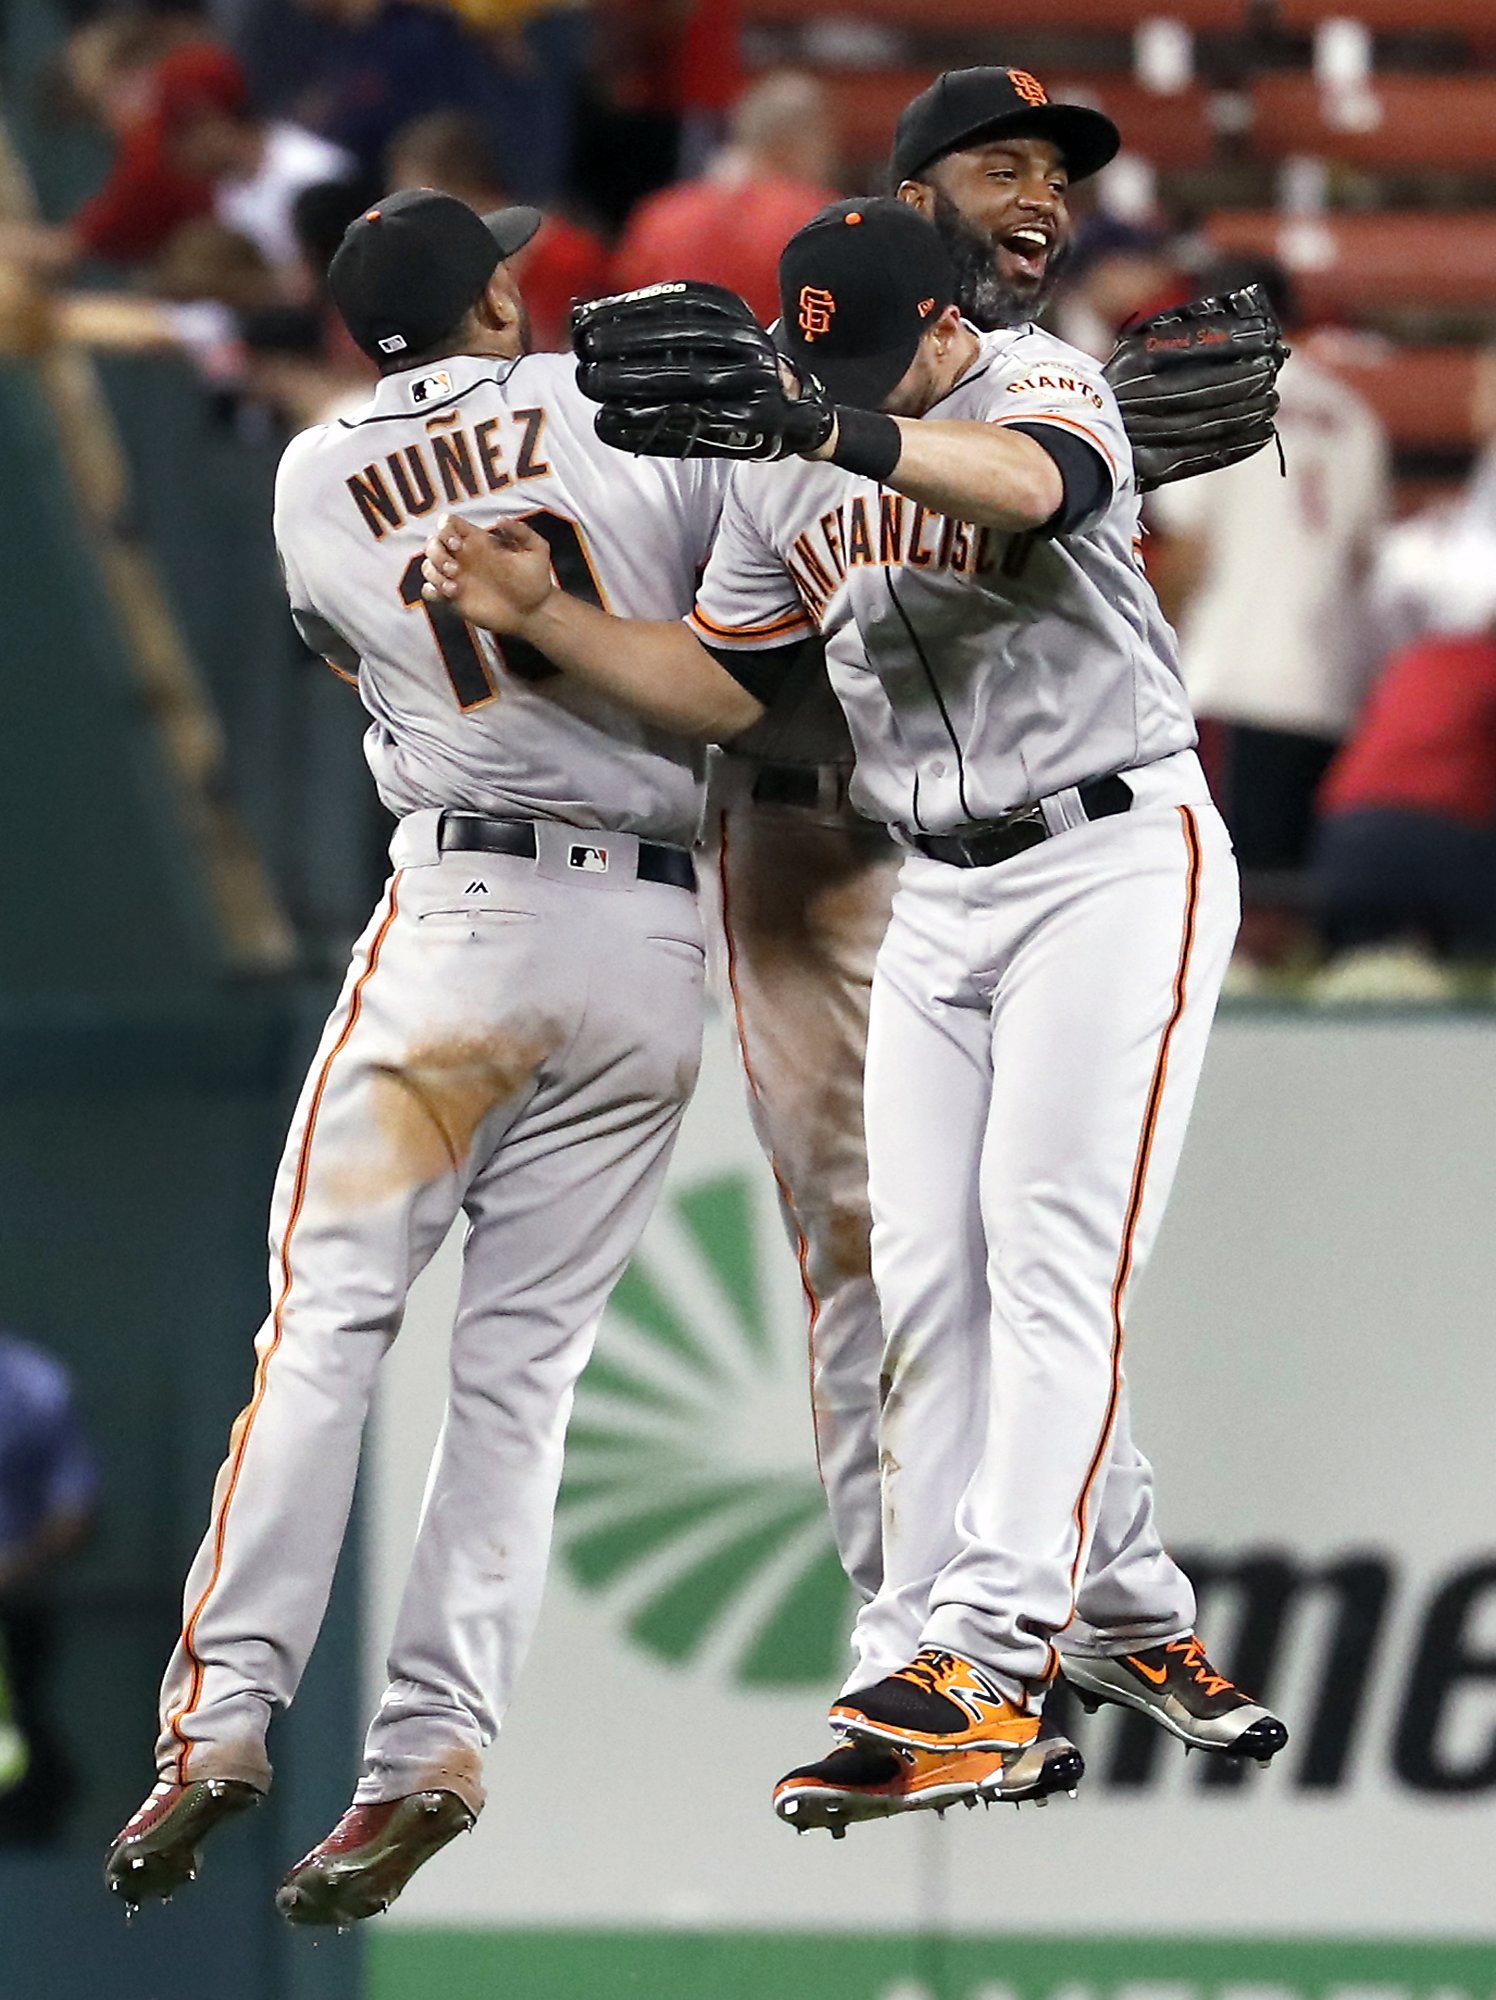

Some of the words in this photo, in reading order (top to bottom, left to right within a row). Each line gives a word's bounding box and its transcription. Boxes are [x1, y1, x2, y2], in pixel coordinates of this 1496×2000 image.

[1005, 375, 1104, 409] GIANTS
[345, 407, 553, 542] NUÑEZ
[819, 493, 1038, 583] FANCISCO
